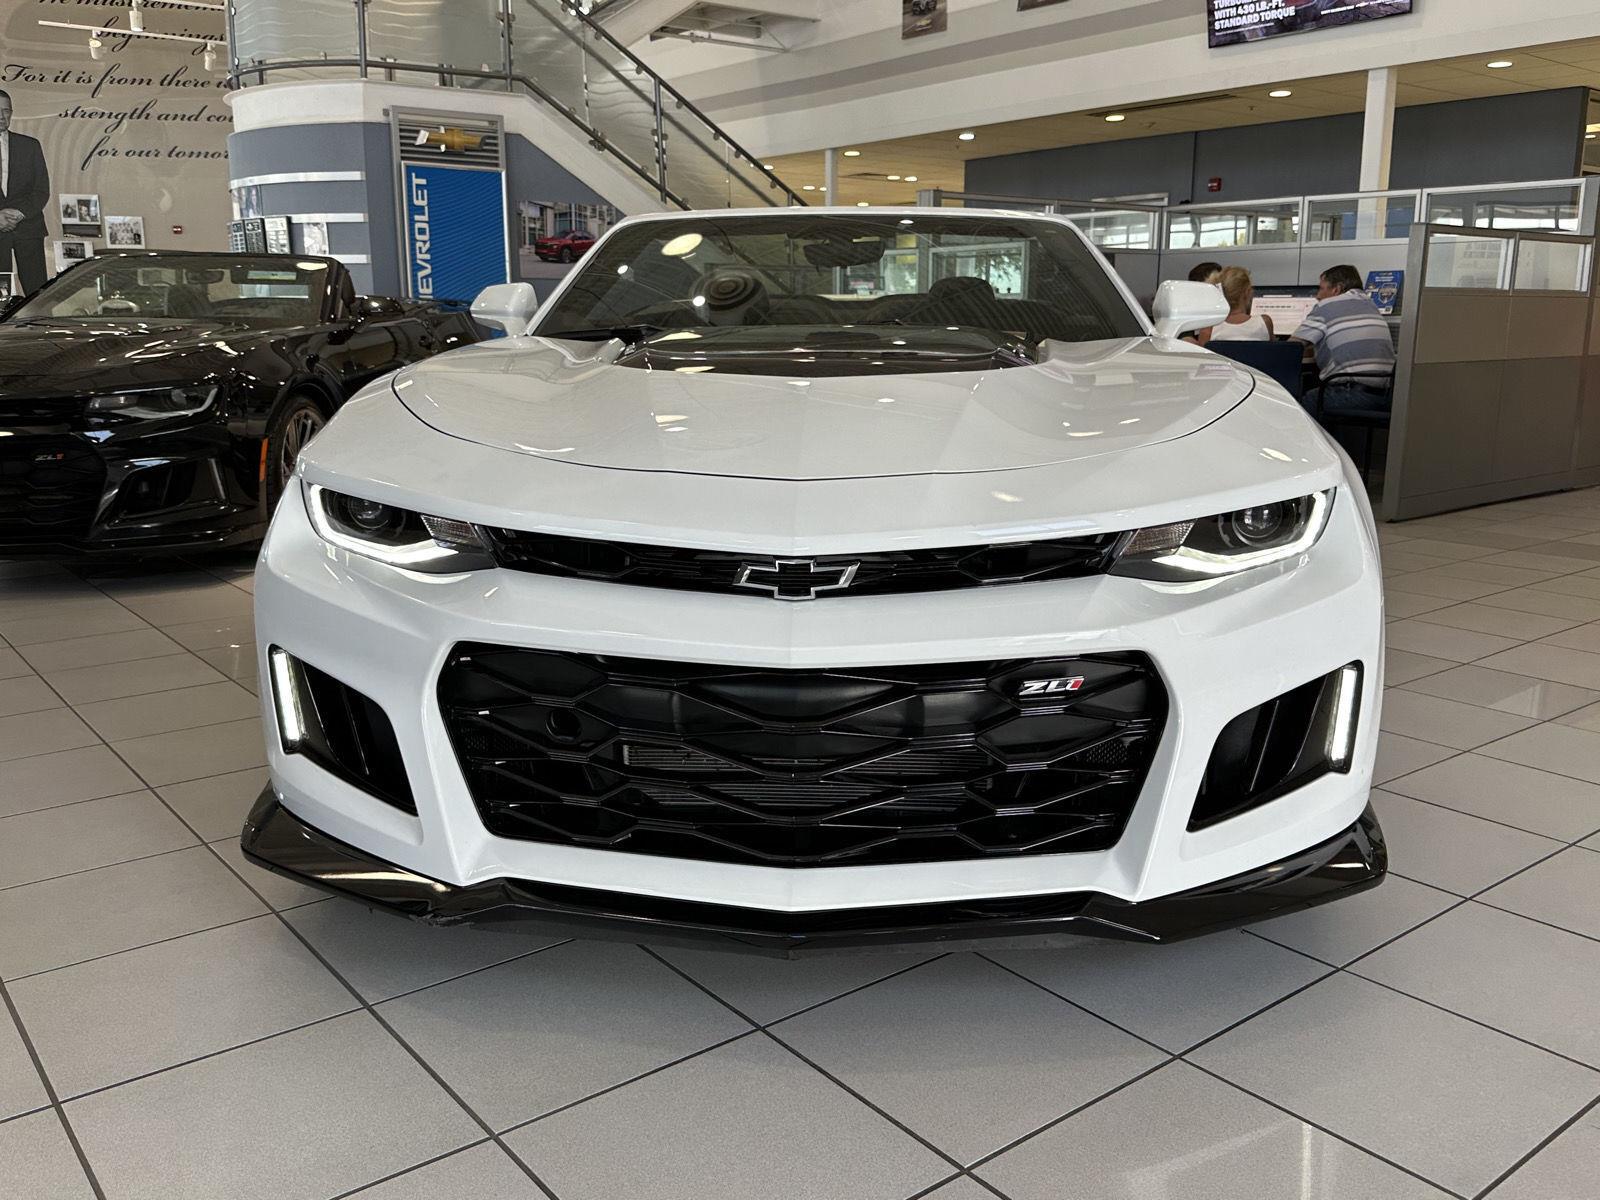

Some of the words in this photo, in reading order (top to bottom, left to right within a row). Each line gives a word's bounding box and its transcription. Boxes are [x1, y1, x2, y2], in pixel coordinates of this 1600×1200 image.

[1214, 7, 1236, 20] WITH
[1214, 14, 1259, 30] STANDARD
[1260, 6, 1296, 20] TORQUE
[2, 64, 46, 83] For
[53, 70, 73, 83] it
[76, 71, 93, 84] is
[91, 63, 153, 99] from
[160, 65, 210, 88] there
[59, 98, 158, 134] strength
[157, 105, 208, 122] and
[81, 136, 119, 171] for
[125, 148, 161, 158] our
[412, 172, 433, 299] EVROLET
[1019, 677, 1085, 696] ZL1
